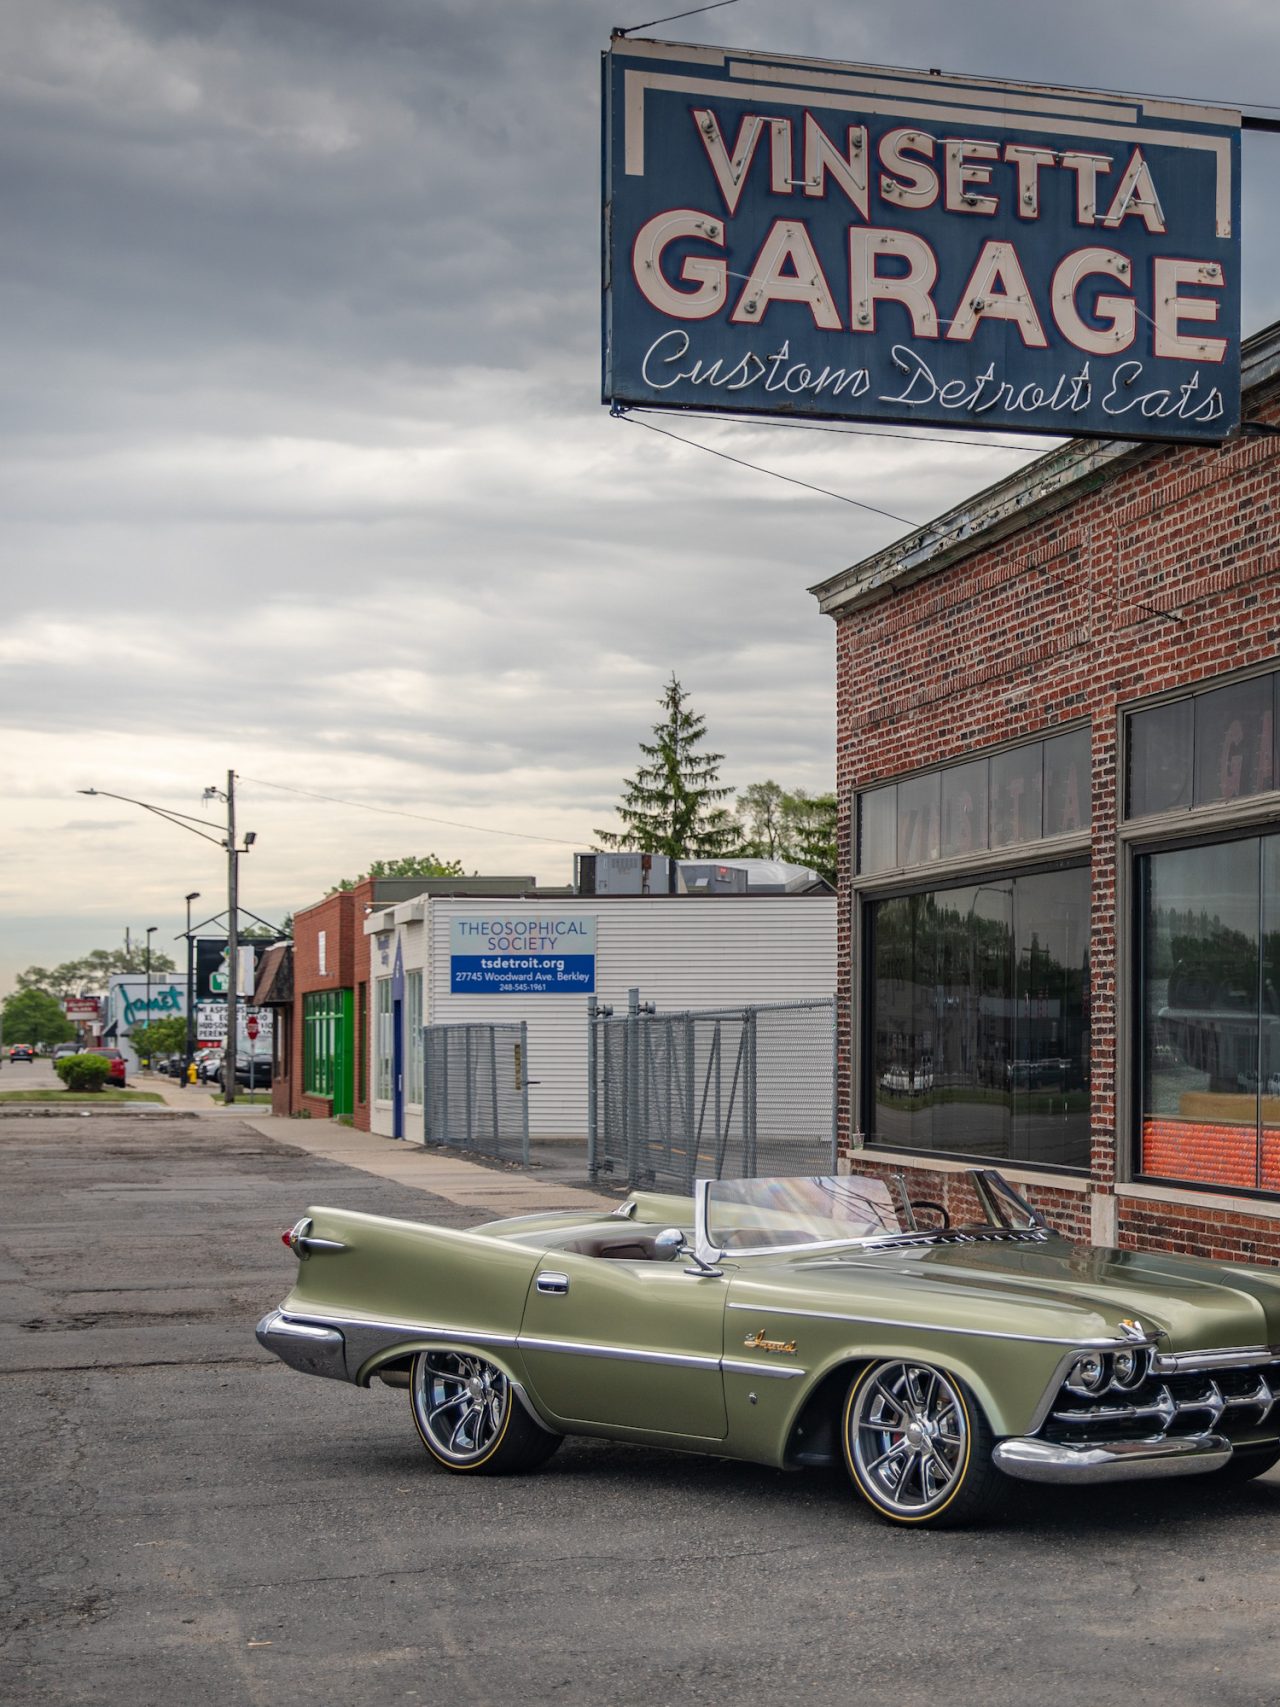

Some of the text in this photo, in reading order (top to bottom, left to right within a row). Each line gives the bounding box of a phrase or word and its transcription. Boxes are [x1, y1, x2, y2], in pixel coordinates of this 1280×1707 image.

[691, 106, 1168, 234] VINSETTA
[631, 208, 1229, 364] GARAGE
[641, 330, 1225, 423] Custom Detroit Eats
[458, 921, 588, 936] THEOSOPHICAL
[488, 937, 558, 951] SOCIETY
[480, 957, 565, 971] tsdetroit.org
[456, 971, 590, 983] 27745 Woodward Ave. Berkley
[499, 983, 546, 992] 248-545-1961
